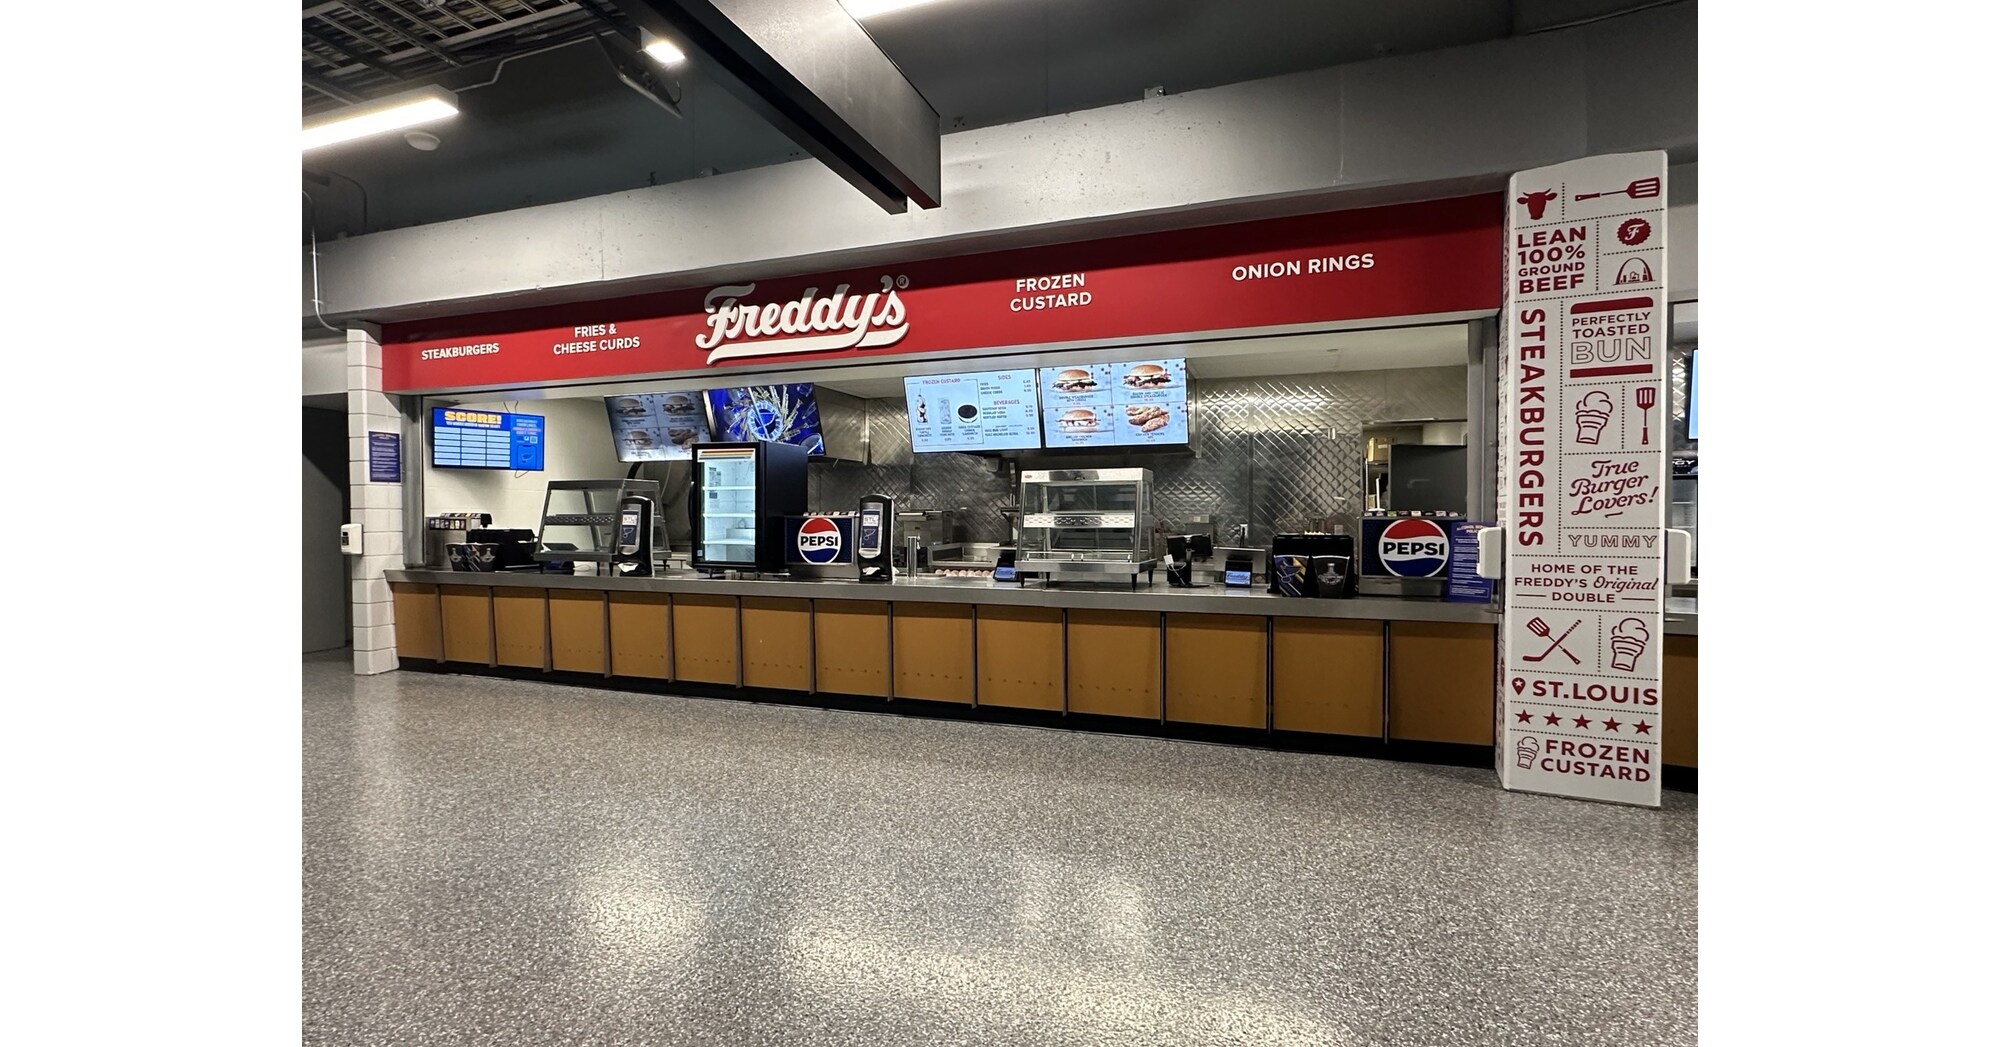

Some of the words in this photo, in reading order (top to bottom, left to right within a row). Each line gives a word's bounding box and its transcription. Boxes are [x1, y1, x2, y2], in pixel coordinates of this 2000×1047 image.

[1517, 226, 1586, 249] LEAN
[1517, 244, 1586, 266] 100%
[1231, 260, 1300, 281] ONION
[1308, 253, 1375, 275] RINGS
[1518, 262, 1586, 277] GROUND
[1016, 273, 1085, 293] FROZEN
[1518, 273, 1585, 295] BEEF
[1010, 291, 1092, 313] CUSTARD
[695, 275, 908, 358] Freddy's
[1572, 311, 1651, 327] PERFECTLY
[574, 324, 606, 338] FRIES
[608, 323, 617, 335] &
[1572, 323, 1650, 339] TOASTED
[421, 343, 500, 360] STEAKBURGERS
[553, 340, 597, 355] CHEESE
[599, 336, 641, 351] CURDS
[1570, 336, 1652, 365] BUN
[444, 411, 502, 425] SCORE!
[1518, 309, 1546, 547] STEAKBURGERS
[1591, 460, 1639, 479] True
[1569, 473, 1649, 500] Burger
[1571, 485, 1659, 516] Lovers!
[800, 535, 839, 547] PEPSI
[1383, 541, 1445, 556] PEPSI
[1568, 534, 1658, 549] YUMMY
[1531, 563, 1575, 574] HOME
[1580, 564, 1602, 575] OF
[1607, 565, 1638, 576] THE
[1514, 576, 1588, 589] FREDDY'S
[1593, 575, 1659, 593] Original
[1552, 591, 1616, 604] DOUBLE
[1532, 679, 1659, 706] ST.LOUIS
[1545, 739, 1650, 765] FROZEN
[1540, 757, 1651, 783] CUSTARD
